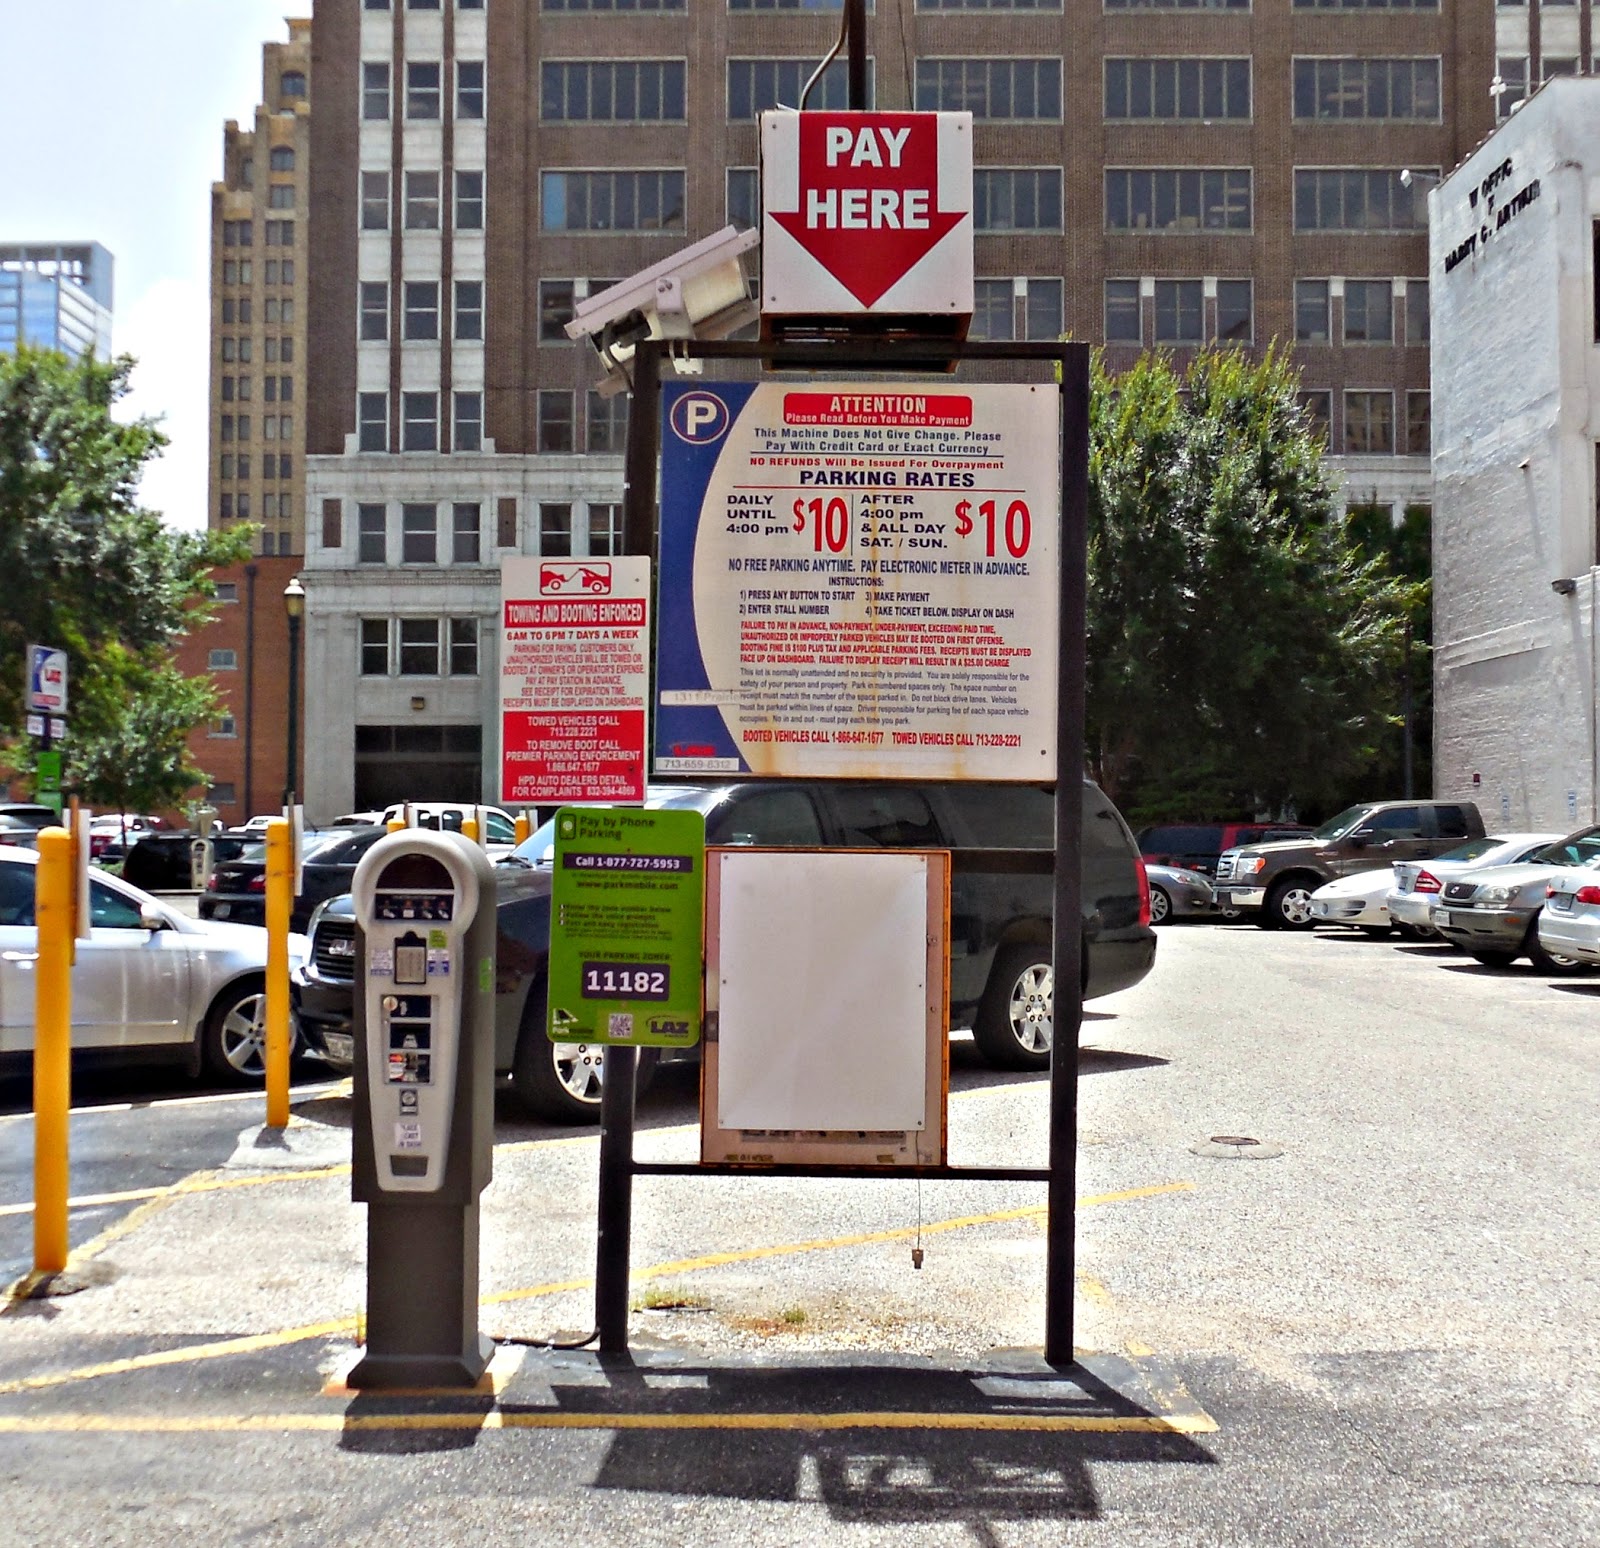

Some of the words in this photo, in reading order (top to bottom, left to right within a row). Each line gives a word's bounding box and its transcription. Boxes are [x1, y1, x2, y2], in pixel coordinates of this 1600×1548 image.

[826, 127, 911, 168] PAY
[807, 189, 930, 229] HERE
[830, 396, 926, 413] ATTENTION
[687, 400, 718, 435] P
[786, 413, 817, 423] Please
[820, 414, 844, 423] Read
[847, 414, 878, 424] Before
[880, 415, 897, 424] You
[900, 416, 926, 425] Make
[929, 415, 970, 427] Payment
[755, 428, 777, 438] This
[781, 428, 829, 438] Machine
[833, 429, 859, 439] Does
[864, 429, 882, 439] Not
[886, 430, 910, 440] Give
[914, 430, 959, 442] Change.
[964, 431, 1002, 441] Please
[766, 441, 786, 453] Pay
[790, 441, 816, 451] With
[819, 441, 854, 451] Credit
[858, 442, 884, 452] Card
[888, 444, 900, 452] or
[904, 442, 934, 452] Exact
[938, 443, 989, 456] Currency
[750, 458, 765, 466] NO
[769, 458, 821, 467] REFUNDS
[825, 458, 846, 467] Will
[851, 458, 865, 467] Be
[869, 459, 905, 468] Issued
[909, 460, 928, 469] For
[932, 460, 1004, 471] Overpayment
[800, 471, 897, 487] PARKING
[905, 472, 975, 488] RATES
[727, 495, 774, 505] DAILY
[860, 495, 915, 505] AFTER
[727, 509, 776, 519] UNTIL
[860, 509, 895, 519] 4:00
[900, 511, 924, 521] pm
[726, 524, 760, 534] 4:00
[765, 526, 789, 536] pm
[793, 497, 849, 553] $10
[860, 523, 872, 533] &
[878, 523, 909, 533] ALL
[914, 524, 947, 534] DAY
[955, 498, 1032, 559] $10
[860, 537, 893, 548] SAT.
[908, 538, 948, 549] SUN.
[729, 558, 742, 570] NO
[744, 559, 767, 571] FREE
[770, 559, 809, 571] PARKING
[812, 560, 855, 572] ANYTIME.
[861, 560, 877, 572] PAY
[880, 560, 938, 573] ELECTRONIC
[940, 561, 971, 574] METER
[973, 562, 983, 574] IN
[985, 562, 1030, 576] ADVANCE.
[828, 577, 884, 587] INSTRUCTIONS:
[748, 590, 771, 599] PRESS
[773, 591, 787, 600] ANY
[790, 591, 819, 600] BUTTON
[821, 592, 830, 600] TO
[832, 592, 856, 601] START
[874, 592, 895, 602] MAKE
[896, 593, 930, 602] PAYMENT
[508, 605, 540, 622] TOWING
[542, 605, 559, 622] AND
[561, 604, 597, 622] BOOTING
[600, 603, 642, 621] ENFORCED
[748, 605, 772, 614] ENTER
[774, 605, 797, 614] STALL
[799, 605, 830, 615] NUMBER
[874, 606, 893, 616] TAKE
[895, 607, 921, 616] TICKET
[951, 608, 981, 618] DISPLAY
[983, 609, 994, 618] ON
[995, 609, 1015, 618] DASH
[576, 631, 600, 640] DAYS
[611, 630, 639, 640] WEEK
[527, 716, 557, 726] TOWED
[559, 716, 597, 726] VEHICLES
[599, 716, 620, 726] CALL
[743, 730, 772, 742] BOOTED
[774, 730, 810, 742] VEHICLES
[812, 731, 829, 742] CALL
[892, 732, 917, 744] TOWED
[919, 733, 954, 745] VEHICLES
[956, 733, 974, 745] CALL
[526, 741, 538, 750] TO
[540, 741, 573, 750] REMOVE
[574, 740, 597, 750] BOOT
[599, 740, 620, 750] CALL
[506, 751, 542, 761] PREMIER
[543, 751, 579, 761] PARKING
[580, 750, 641, 760] ENFORCEMENT
[580, 817, 600, 828] Pay
[603, 817, 616, 828] by
[620, 817, 656, 827] Phone
[580, 828, 622, 841] Parking
[575, 856, 594, 866] Call
[587, 970, 664, 993] 11182
[650, 1020, 689, 1034] LAZ
